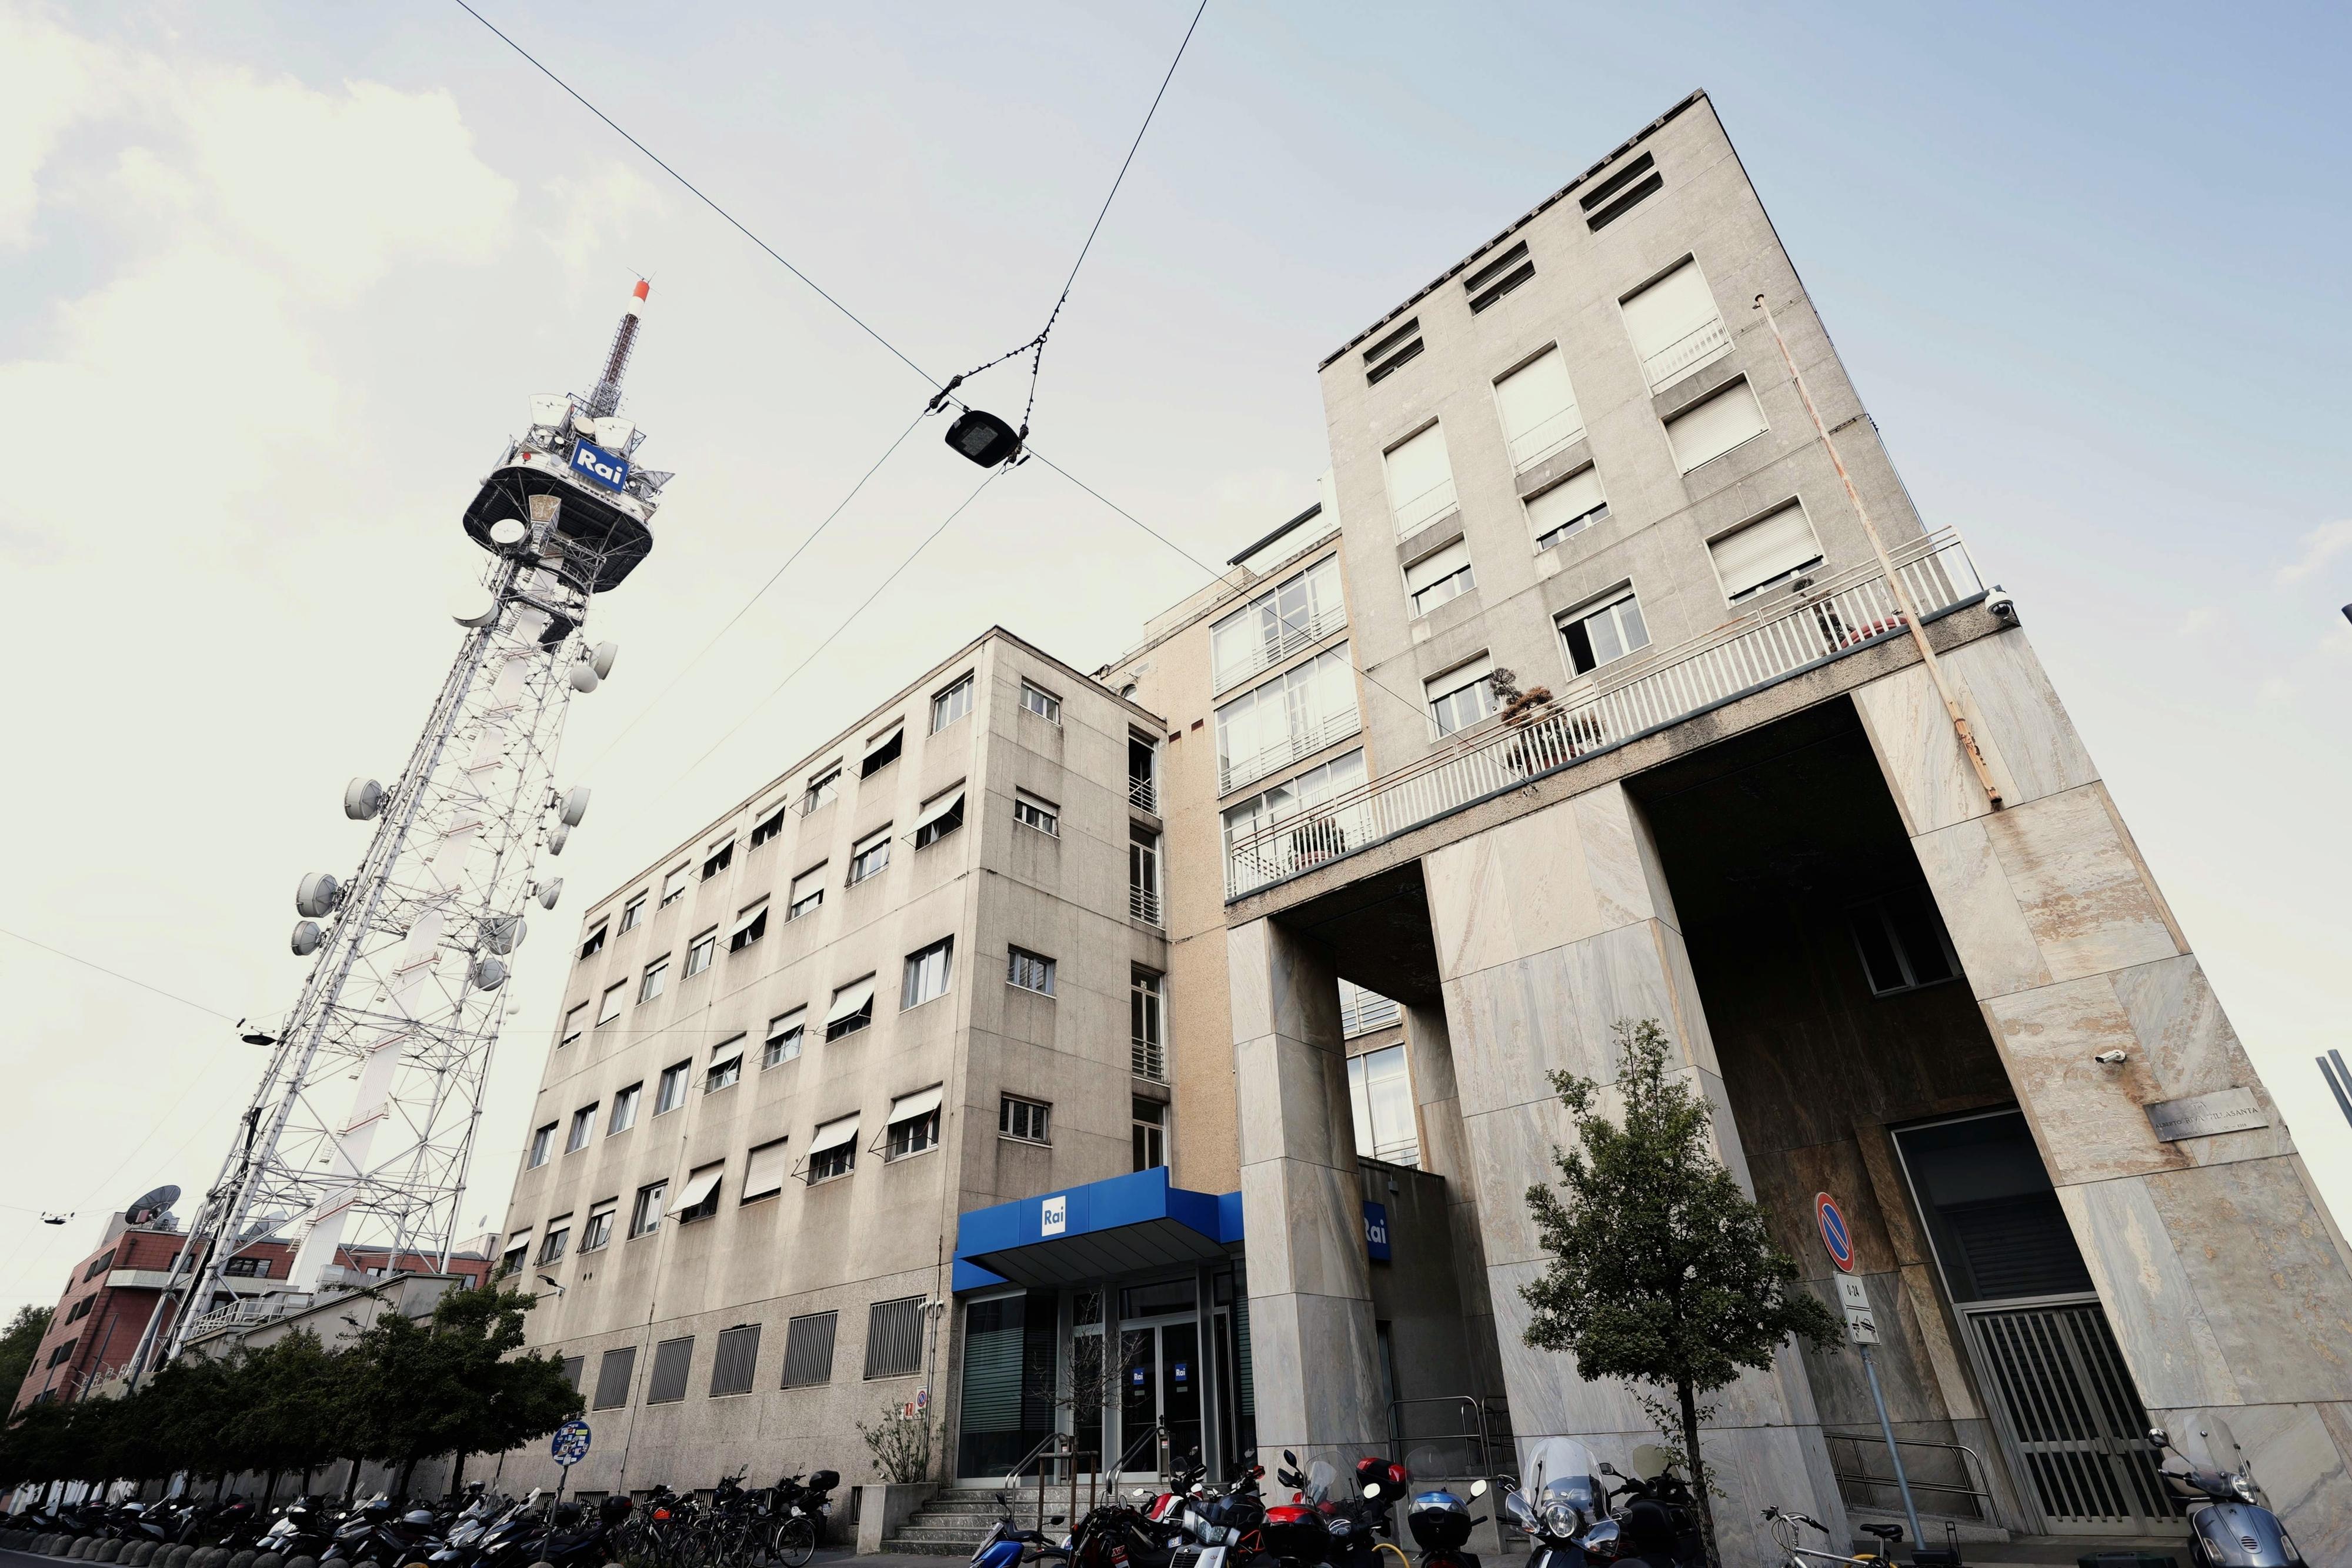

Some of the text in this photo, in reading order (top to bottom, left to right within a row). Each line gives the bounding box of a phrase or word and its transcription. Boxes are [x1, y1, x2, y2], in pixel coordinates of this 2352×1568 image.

[577, 448, 623, 484] Rai
[2155, 1120, 2182, 1129] ALBERTO
[1045, 1206, 1063, 1226] Rai
[1134, 1372, 1143, 1380] Rai
[1176, 1367, 1186, 1377] Rai
